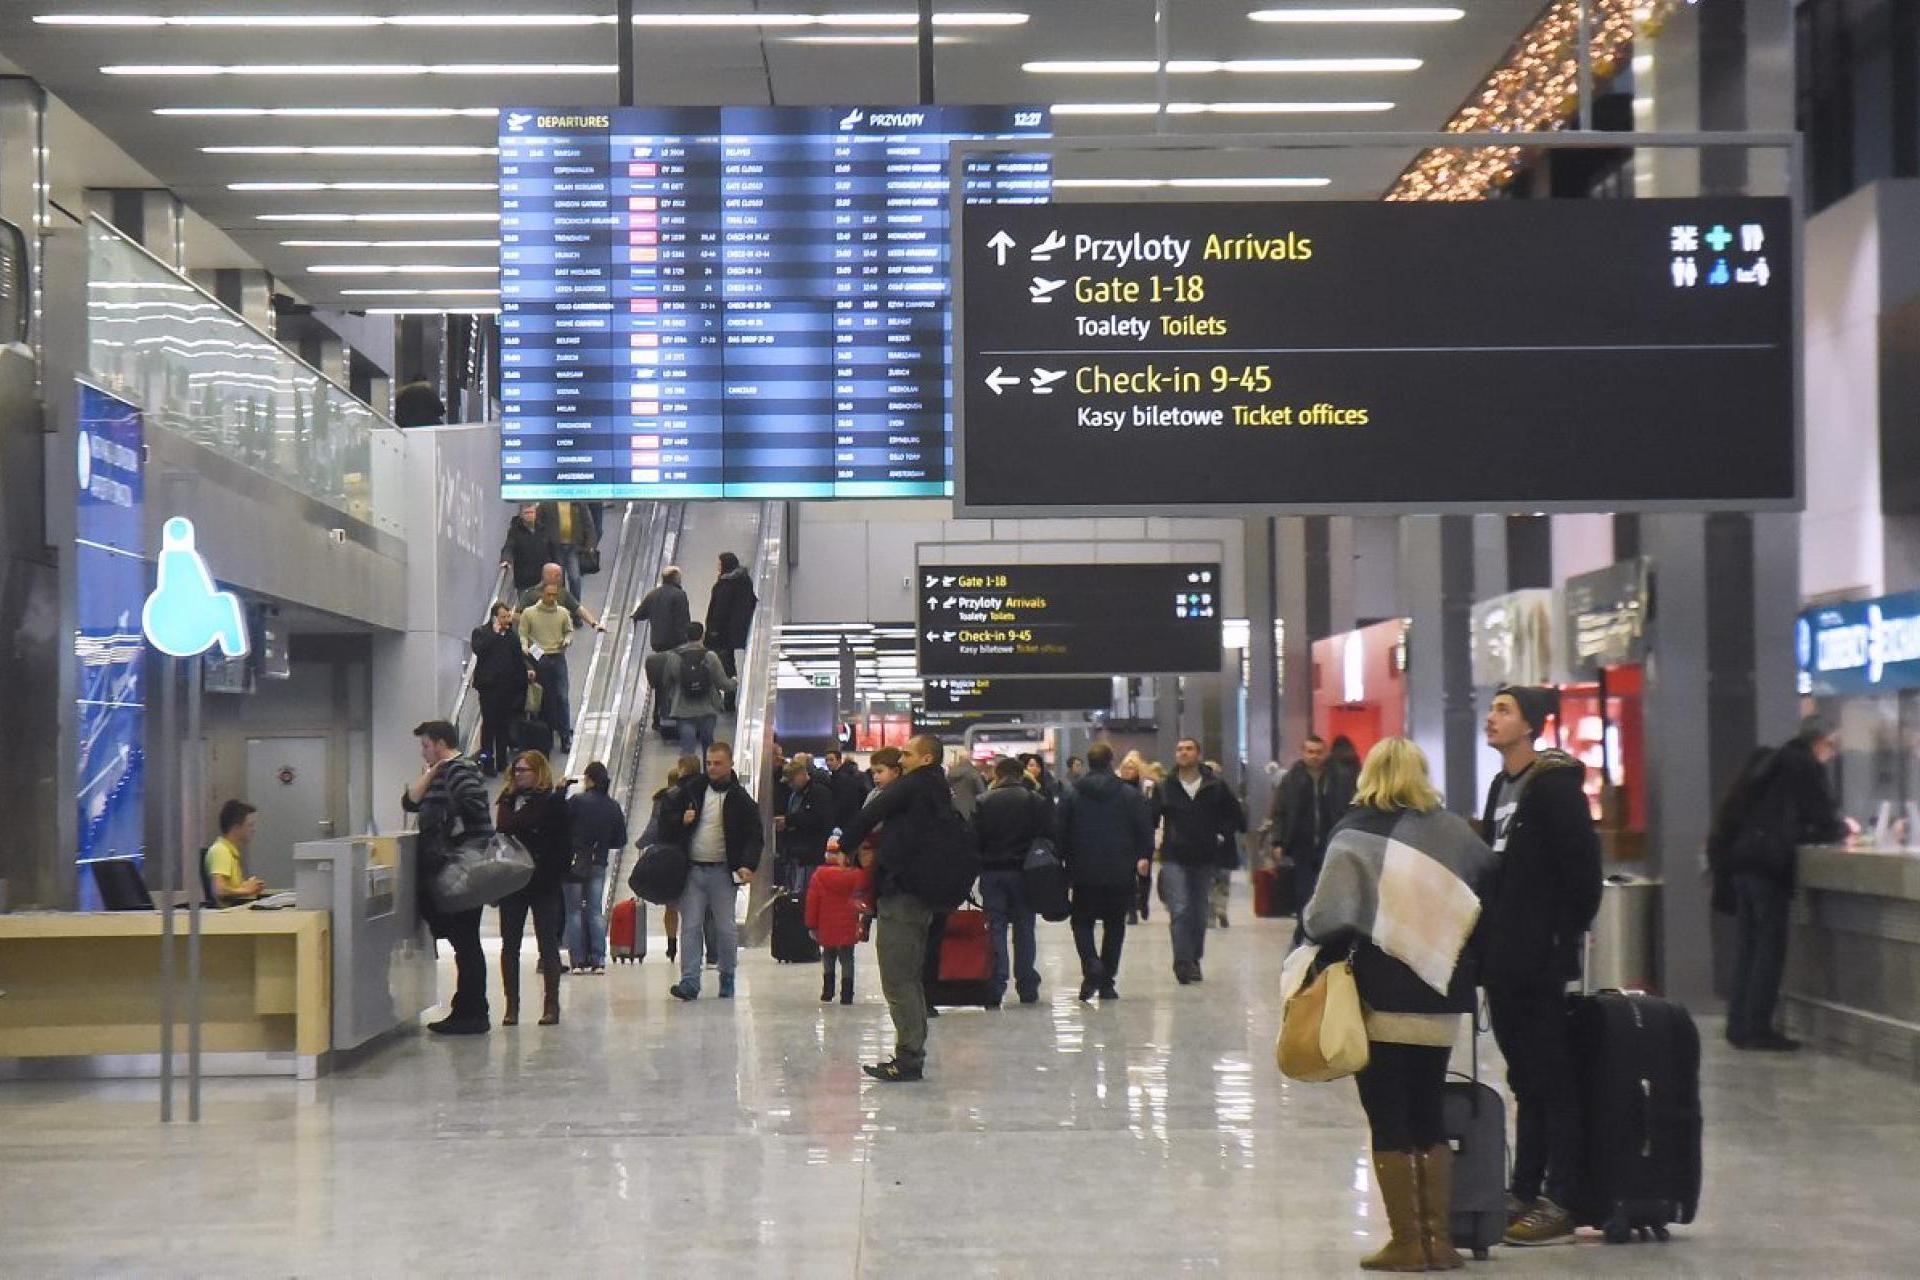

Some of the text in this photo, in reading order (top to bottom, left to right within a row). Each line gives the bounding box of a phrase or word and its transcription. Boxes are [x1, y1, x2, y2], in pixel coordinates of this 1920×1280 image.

[538, 115, 608, 128] DEPARTURES
[870, 113, 924, 127] PRZYLOTY
[1074, 231, 1312, 267] Przyloty Arrivals
[1075, 275, 1205, 303] Gate 1-18
[1075, 315, 1227, 342] Toalety Toilets
[1075, 365, 1272, 394] Check-in 9-45
[1078, 404, 1369, 431] Kasy biletowe Ticket offices
[959, 576, 1007, 587] Gate 1-18
[959, 597, 1046, 610] Przyloty Arrivals
[959, 612, 987, 622] Toalety
[959, 630, 1032, 642] Check-in 9-45
